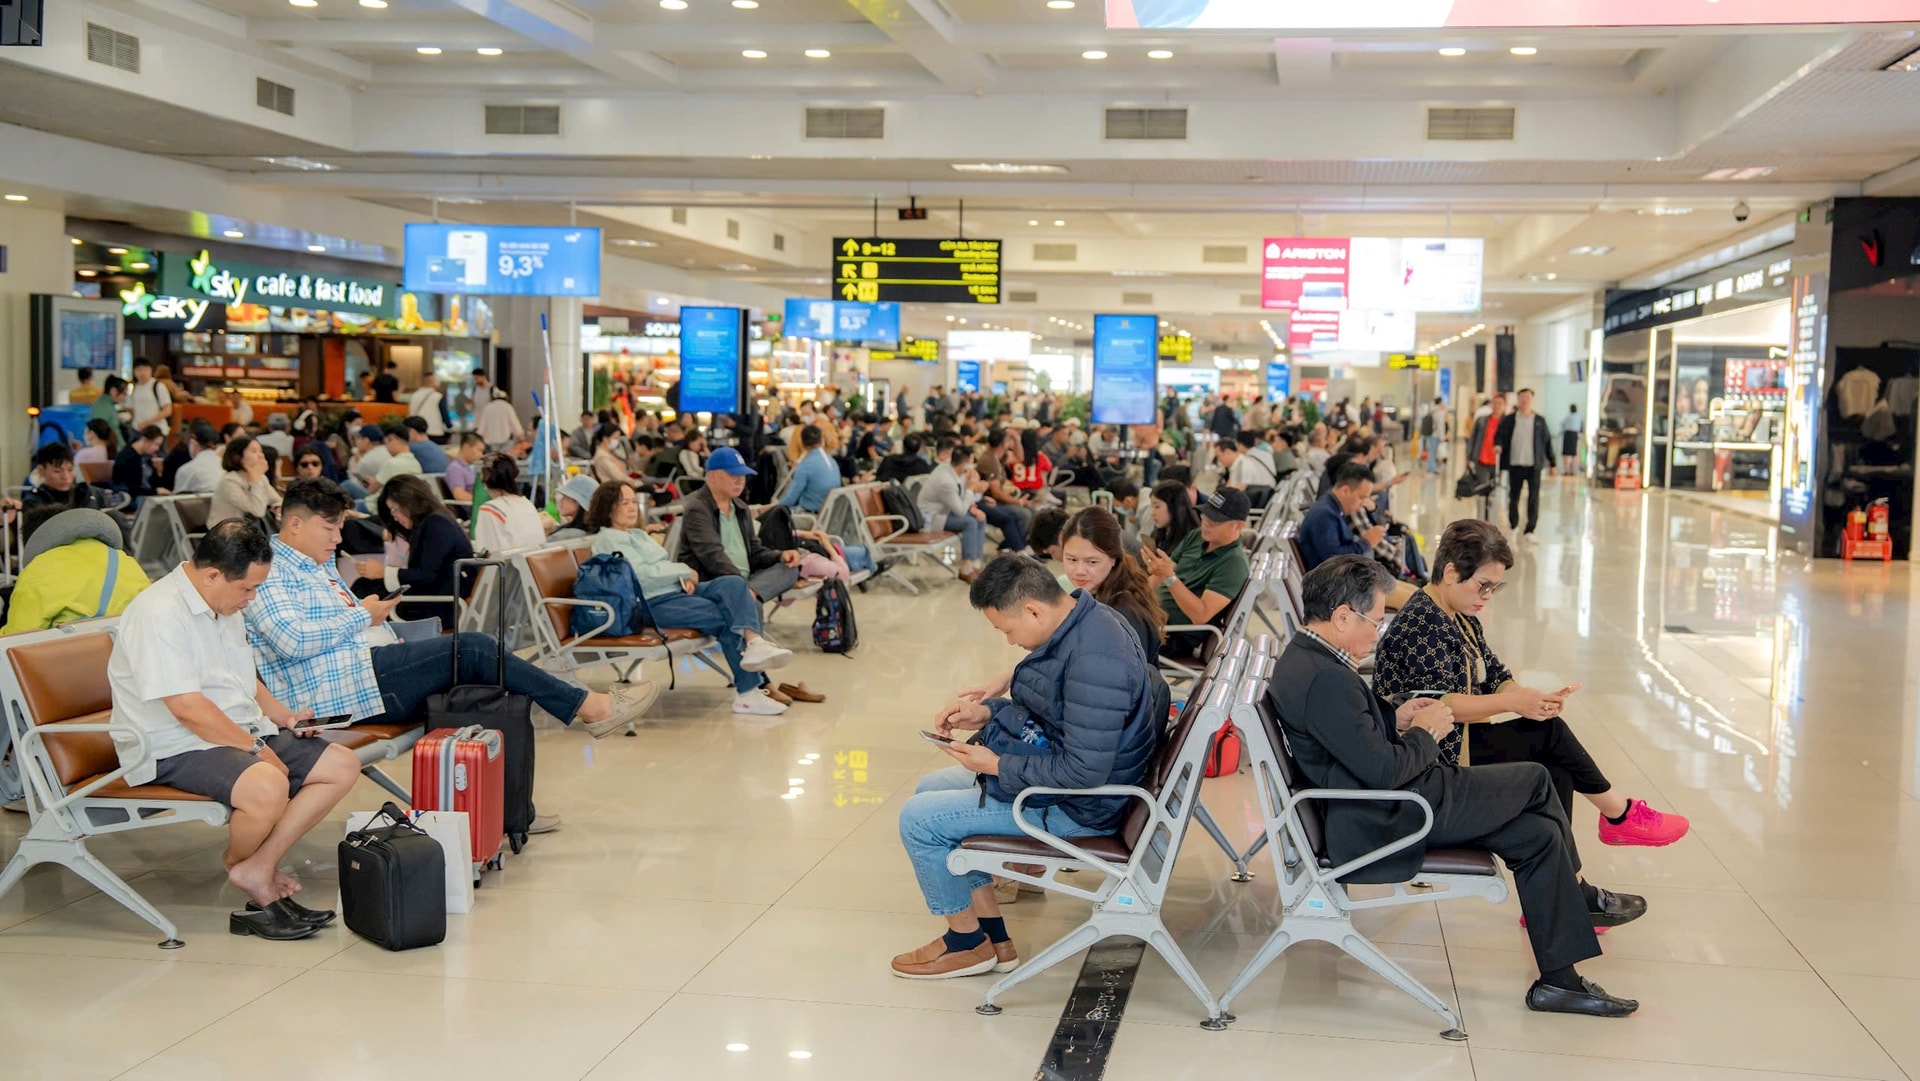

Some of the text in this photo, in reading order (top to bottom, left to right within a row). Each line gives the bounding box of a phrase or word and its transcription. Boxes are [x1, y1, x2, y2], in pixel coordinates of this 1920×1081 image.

[1282, 248, 1346, 259] ARISTON
[210, 270, 384, 308] sky cafe & fast food
[149, 296, 209, 330] sky
[1013, 462, 1037, 482] 91
